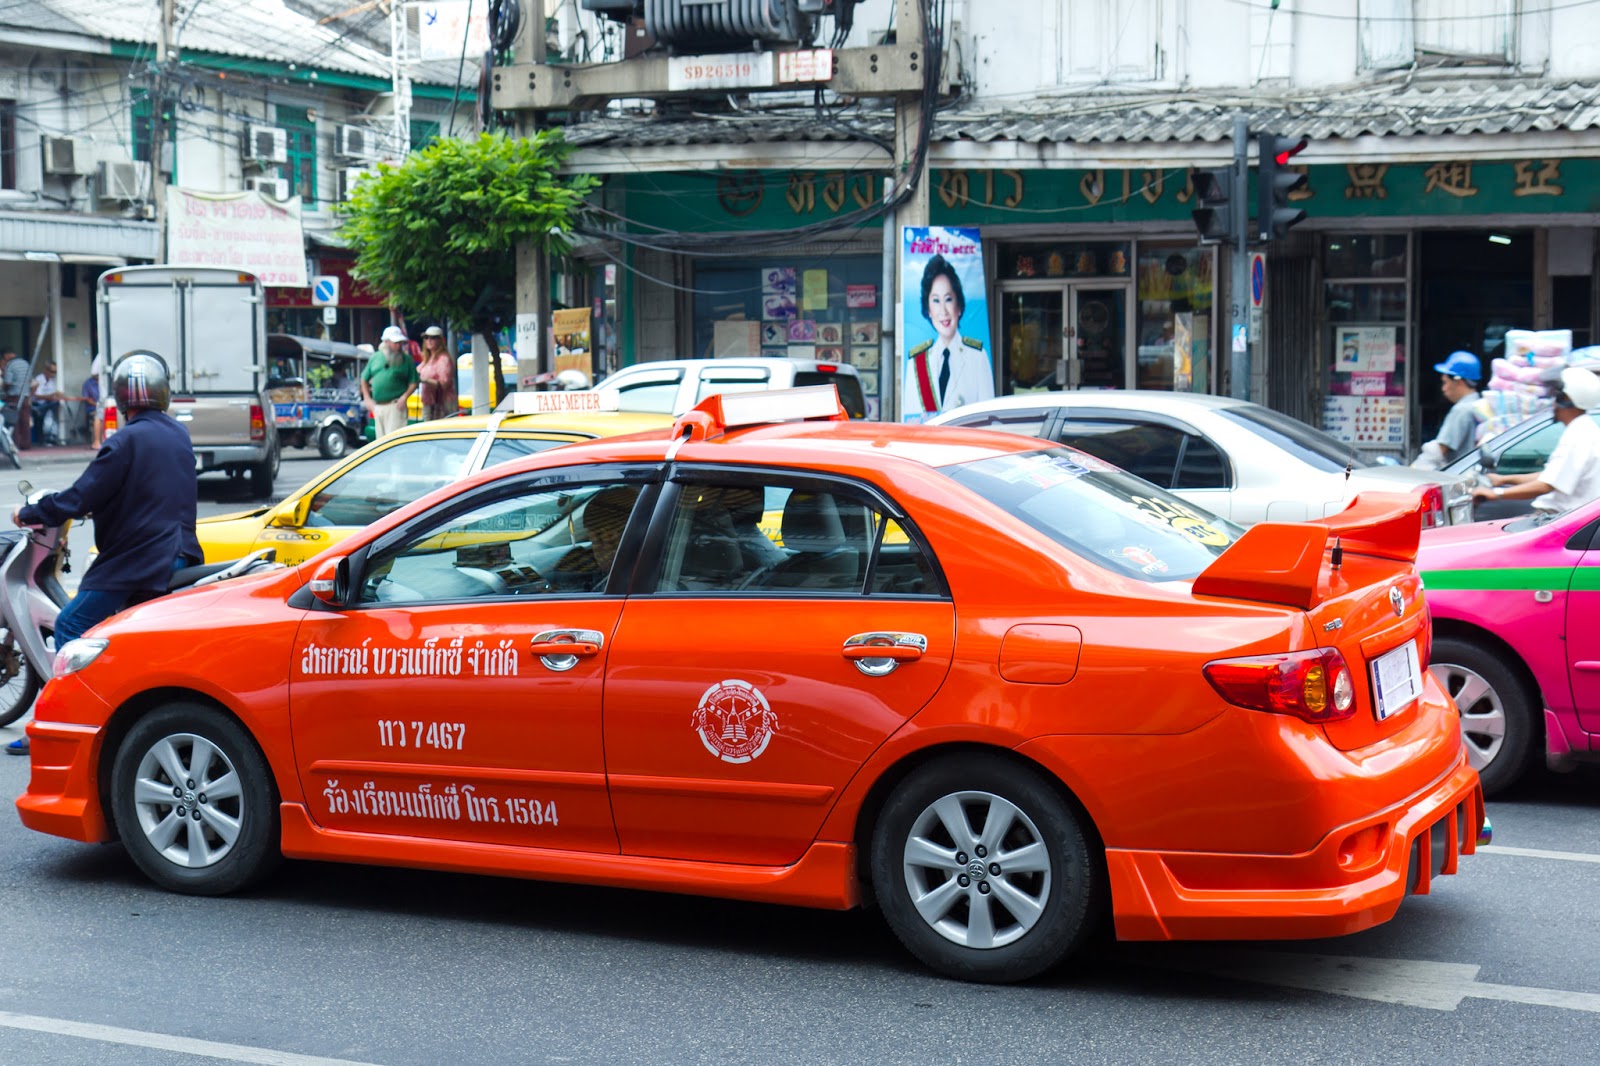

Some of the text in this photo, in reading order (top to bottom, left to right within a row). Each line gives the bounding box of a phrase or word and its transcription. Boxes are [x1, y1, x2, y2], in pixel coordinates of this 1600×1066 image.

[684, 64, 751, 79] SD26519
[301, 635, 518, 676] สหกรณ์ บวรแท็กซี่ จำกัด
[411, 721, 466, 750] 7467
[323, 779, 559, 827] ร้องเรียนแท็กซี่ โทร.1584
